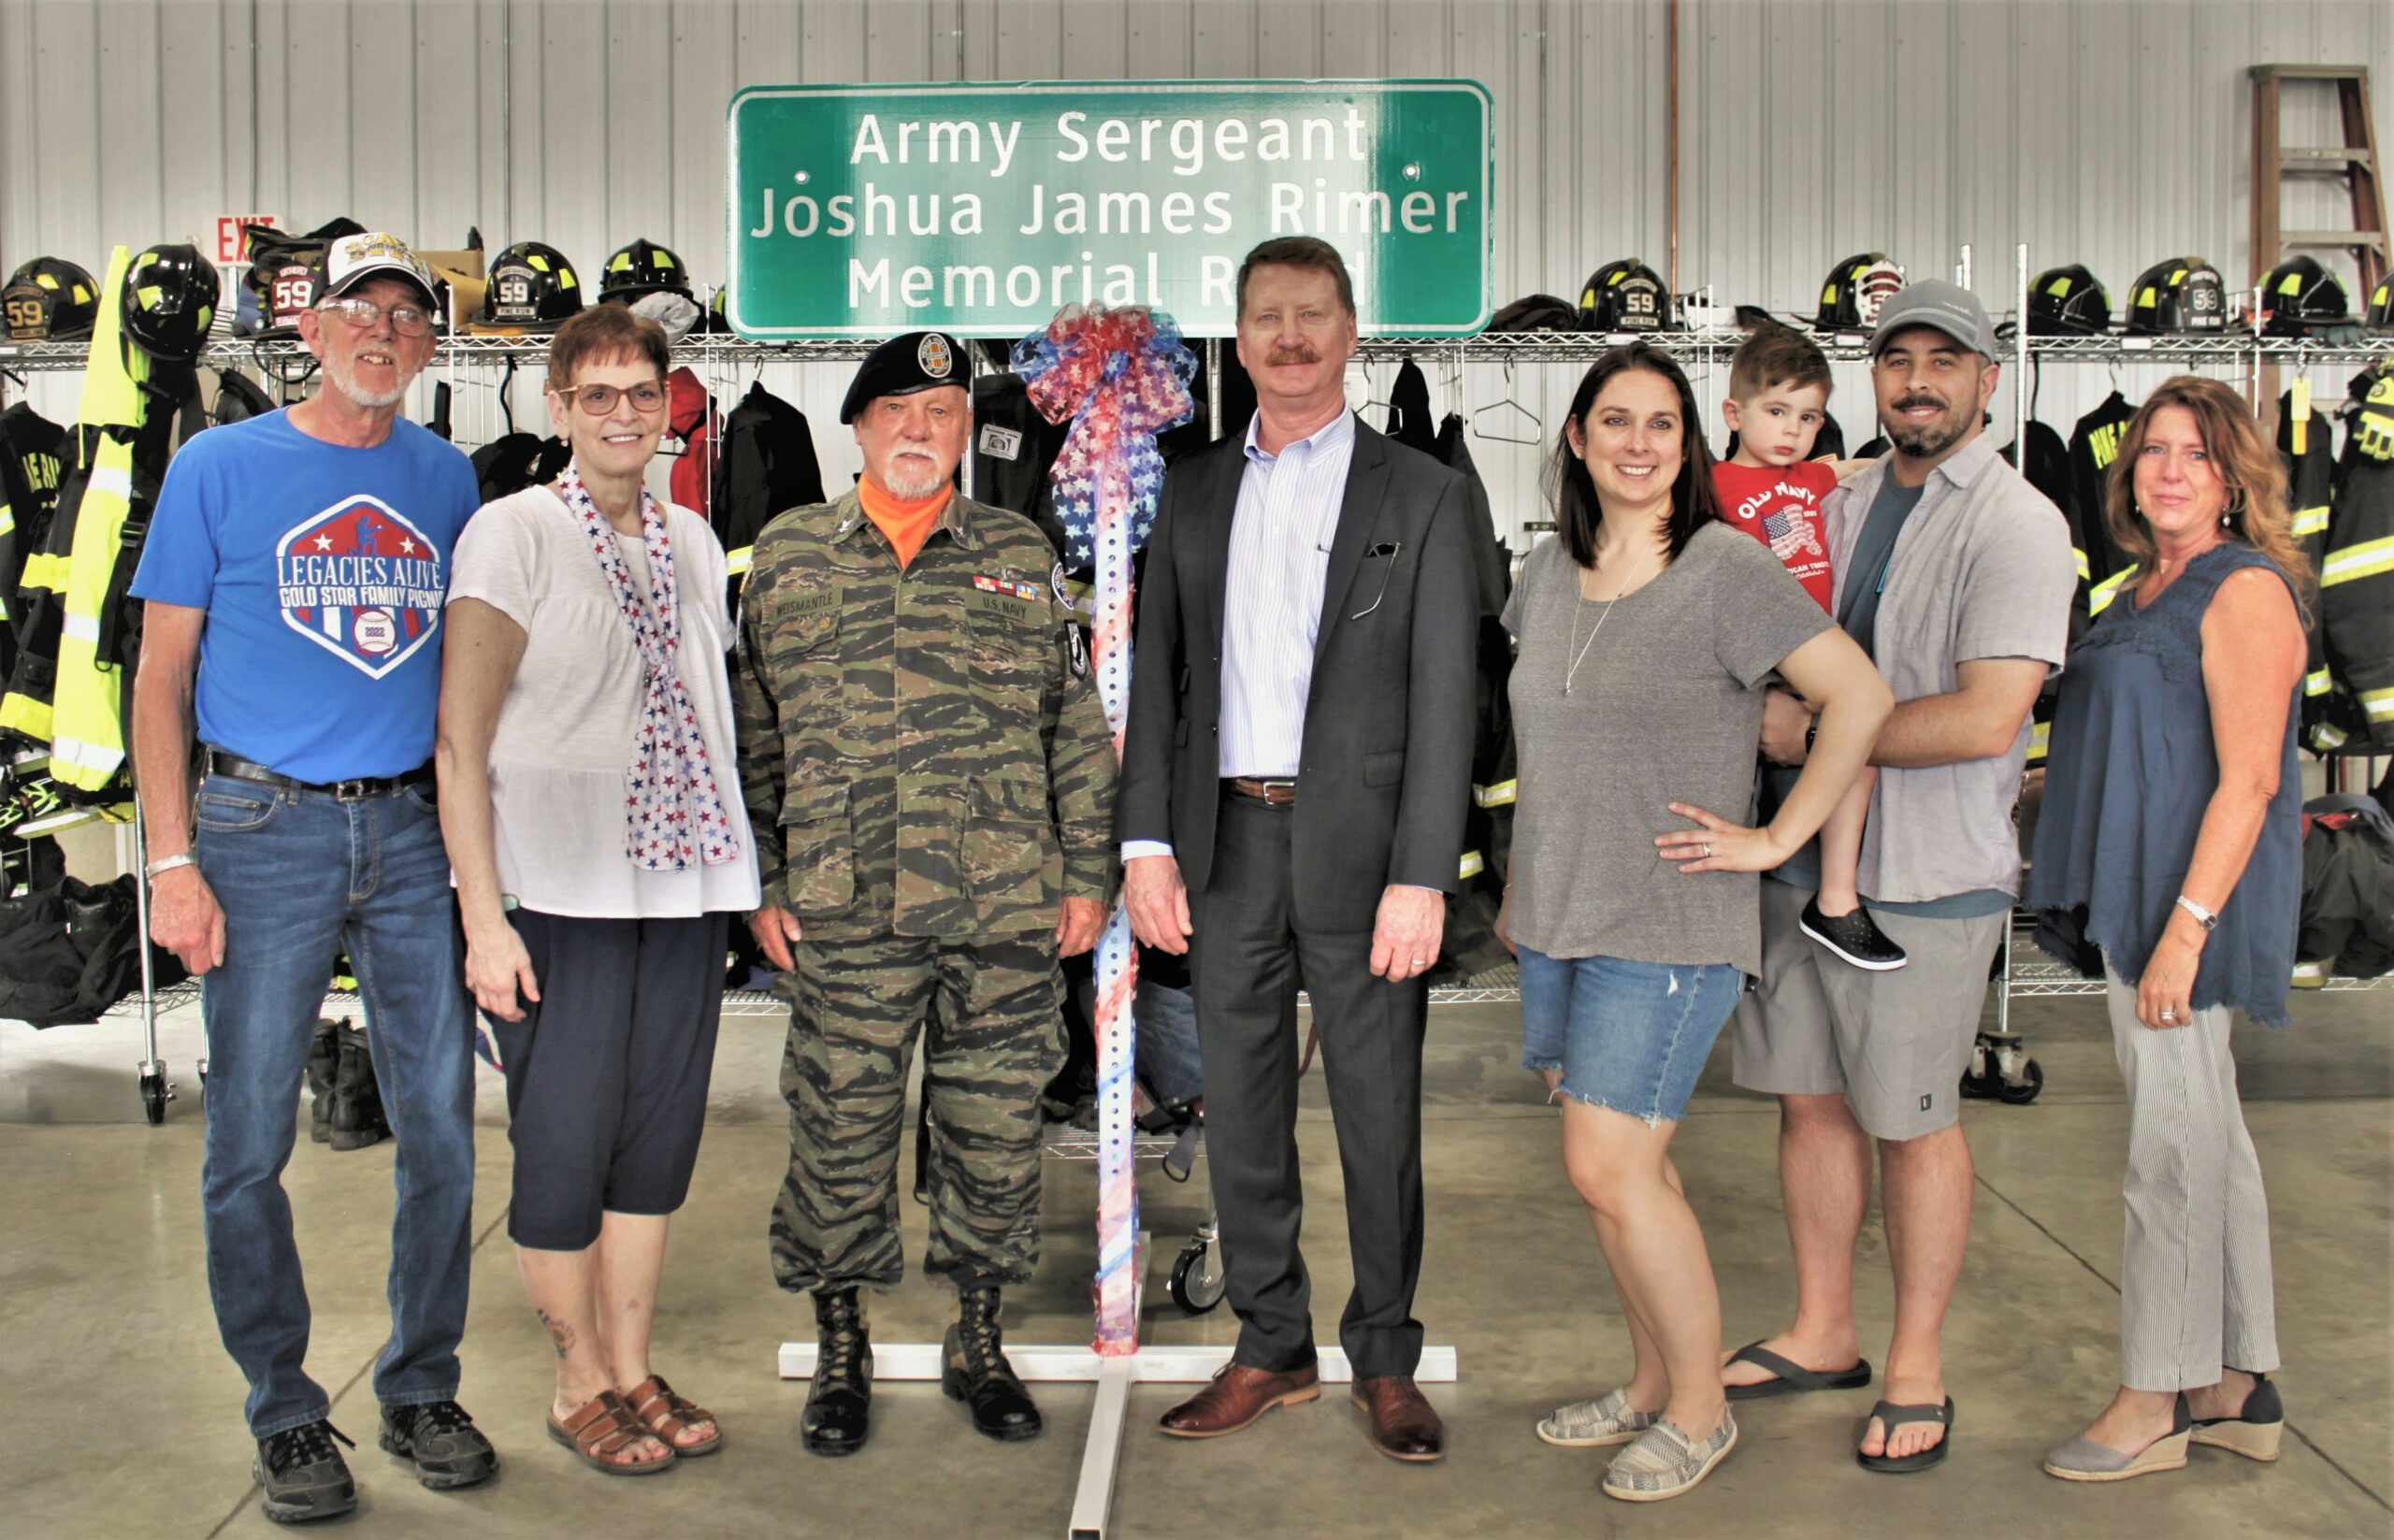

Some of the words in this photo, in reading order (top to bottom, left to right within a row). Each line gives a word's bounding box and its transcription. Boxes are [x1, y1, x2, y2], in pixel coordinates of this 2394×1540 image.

[850, 113, 1022, 178] Army
[1057, 108, 1365, 176] Sergeant
[750, 181, 983, 237] Joshua
[1019, 184, 1233, 235] James
[1271, 178, 1468, 235] Rimer
[499, 281, 528, 303] 59
[848, 251, 1163, 309] Memorial
[276, 281, 312, 309] 59
[1626, 293, 1654, 312] 59
[2193, 289, 2217, 310] 59
[6, 300, 43, 327] 59
[1738, 490, 1772, 519] OLD
[1774, 481, 1816, 506] NAVY
[278, 555, 388, 587] LEGACIES
[393, 557, 444, 590] ALIVE
[281, 586, 318, 608] GOLD
[321, 585, 357, 607] STAR
[360, 586, 406, 608] FAMILY
[776, 592, 832, 619] WEISMANTLE
[1002, 601, 1027, 619] NAVY
[366, 626, 385, 638] 2022
